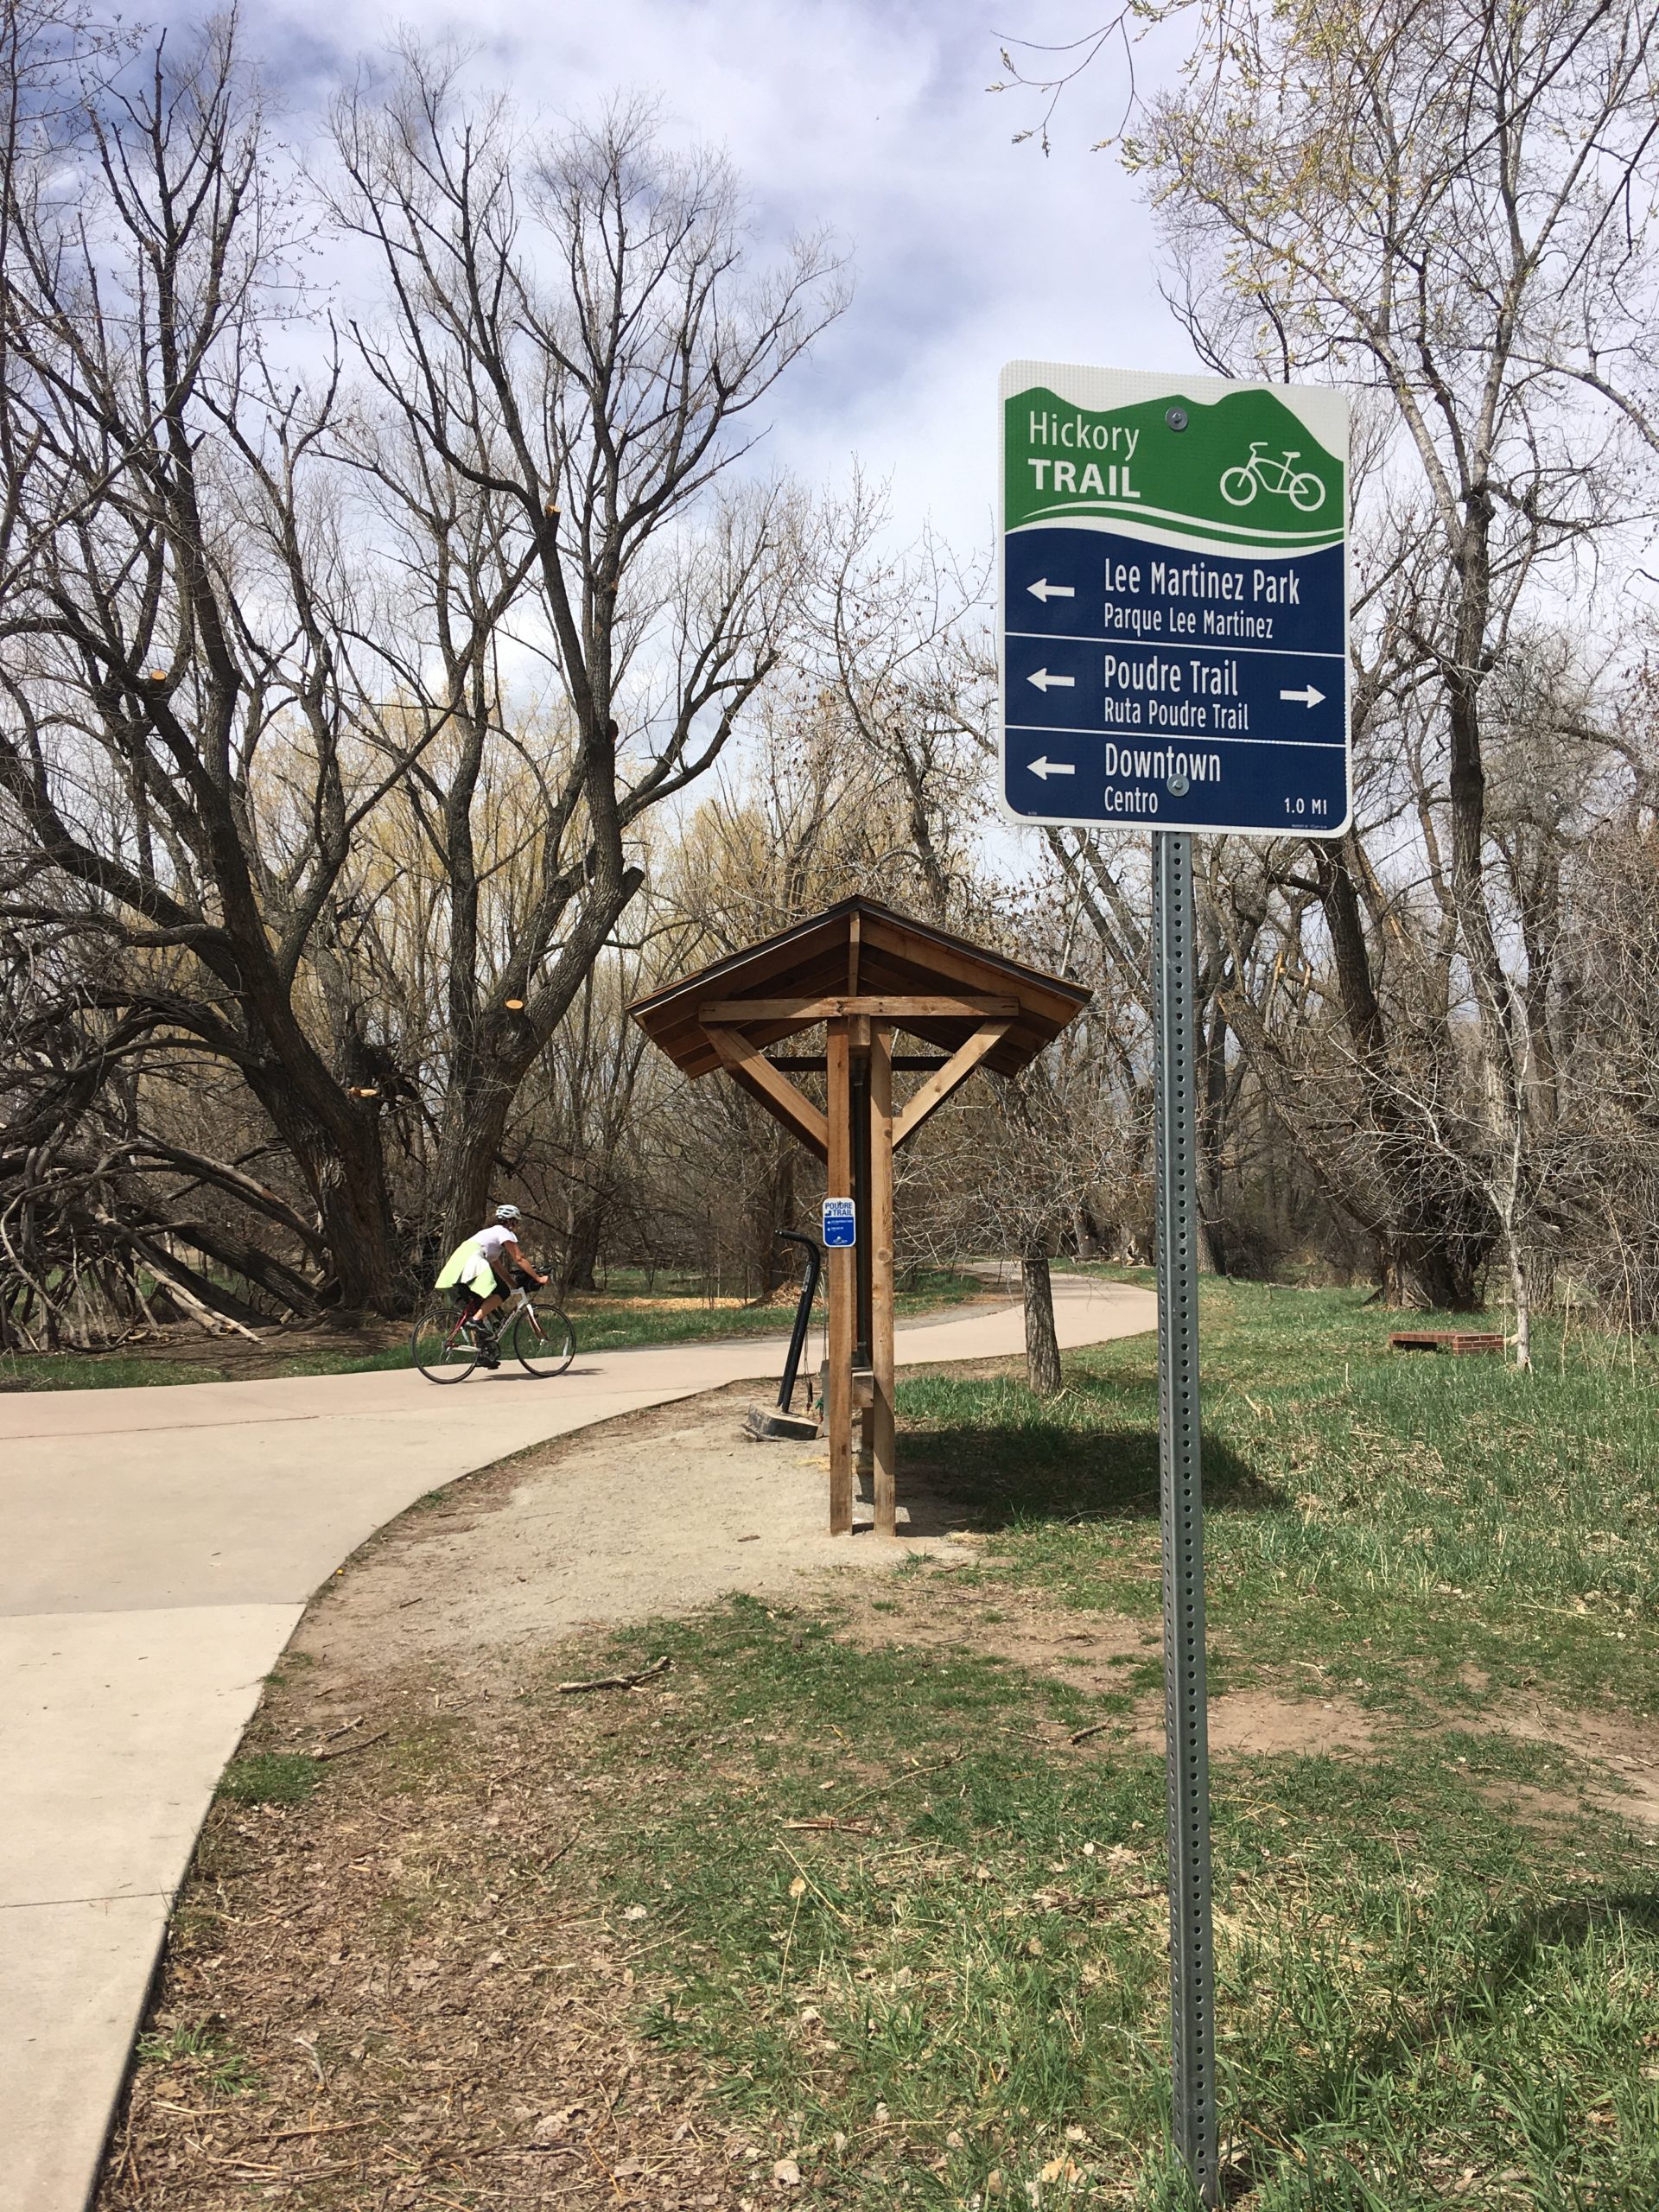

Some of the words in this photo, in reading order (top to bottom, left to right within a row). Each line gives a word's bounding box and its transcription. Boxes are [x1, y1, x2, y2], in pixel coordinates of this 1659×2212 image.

[1029, 410, 1140, 461] Hickory
[1027, 458, 1141, 499] TRAIL
[1105, 558, 1141, 594] Lee
[1151, 562, 1244, 601] Martinez
[1253, 569, 1300, 605] Park
[1104, 602, 1162, 638] Parque
[1169, 607, 1197, 633] Lee
[1204, 609, 1274, 639] Martinez
[1104, 654, 1182, 693] Poudre
[1190, 659, 1238, 696] Trail
[1104, 696, 1141, 724] Ruta
[1148, 699, 1206, 728] Poudre
[1212, 702, 1249, 730] Trail
[1105, 742, 1221, 782] Downtown
[1104, 785, 1159, 814] Centro
[1284, 797, 1305, 814] 1.0
[1312, 798, 1327, 815] MI
